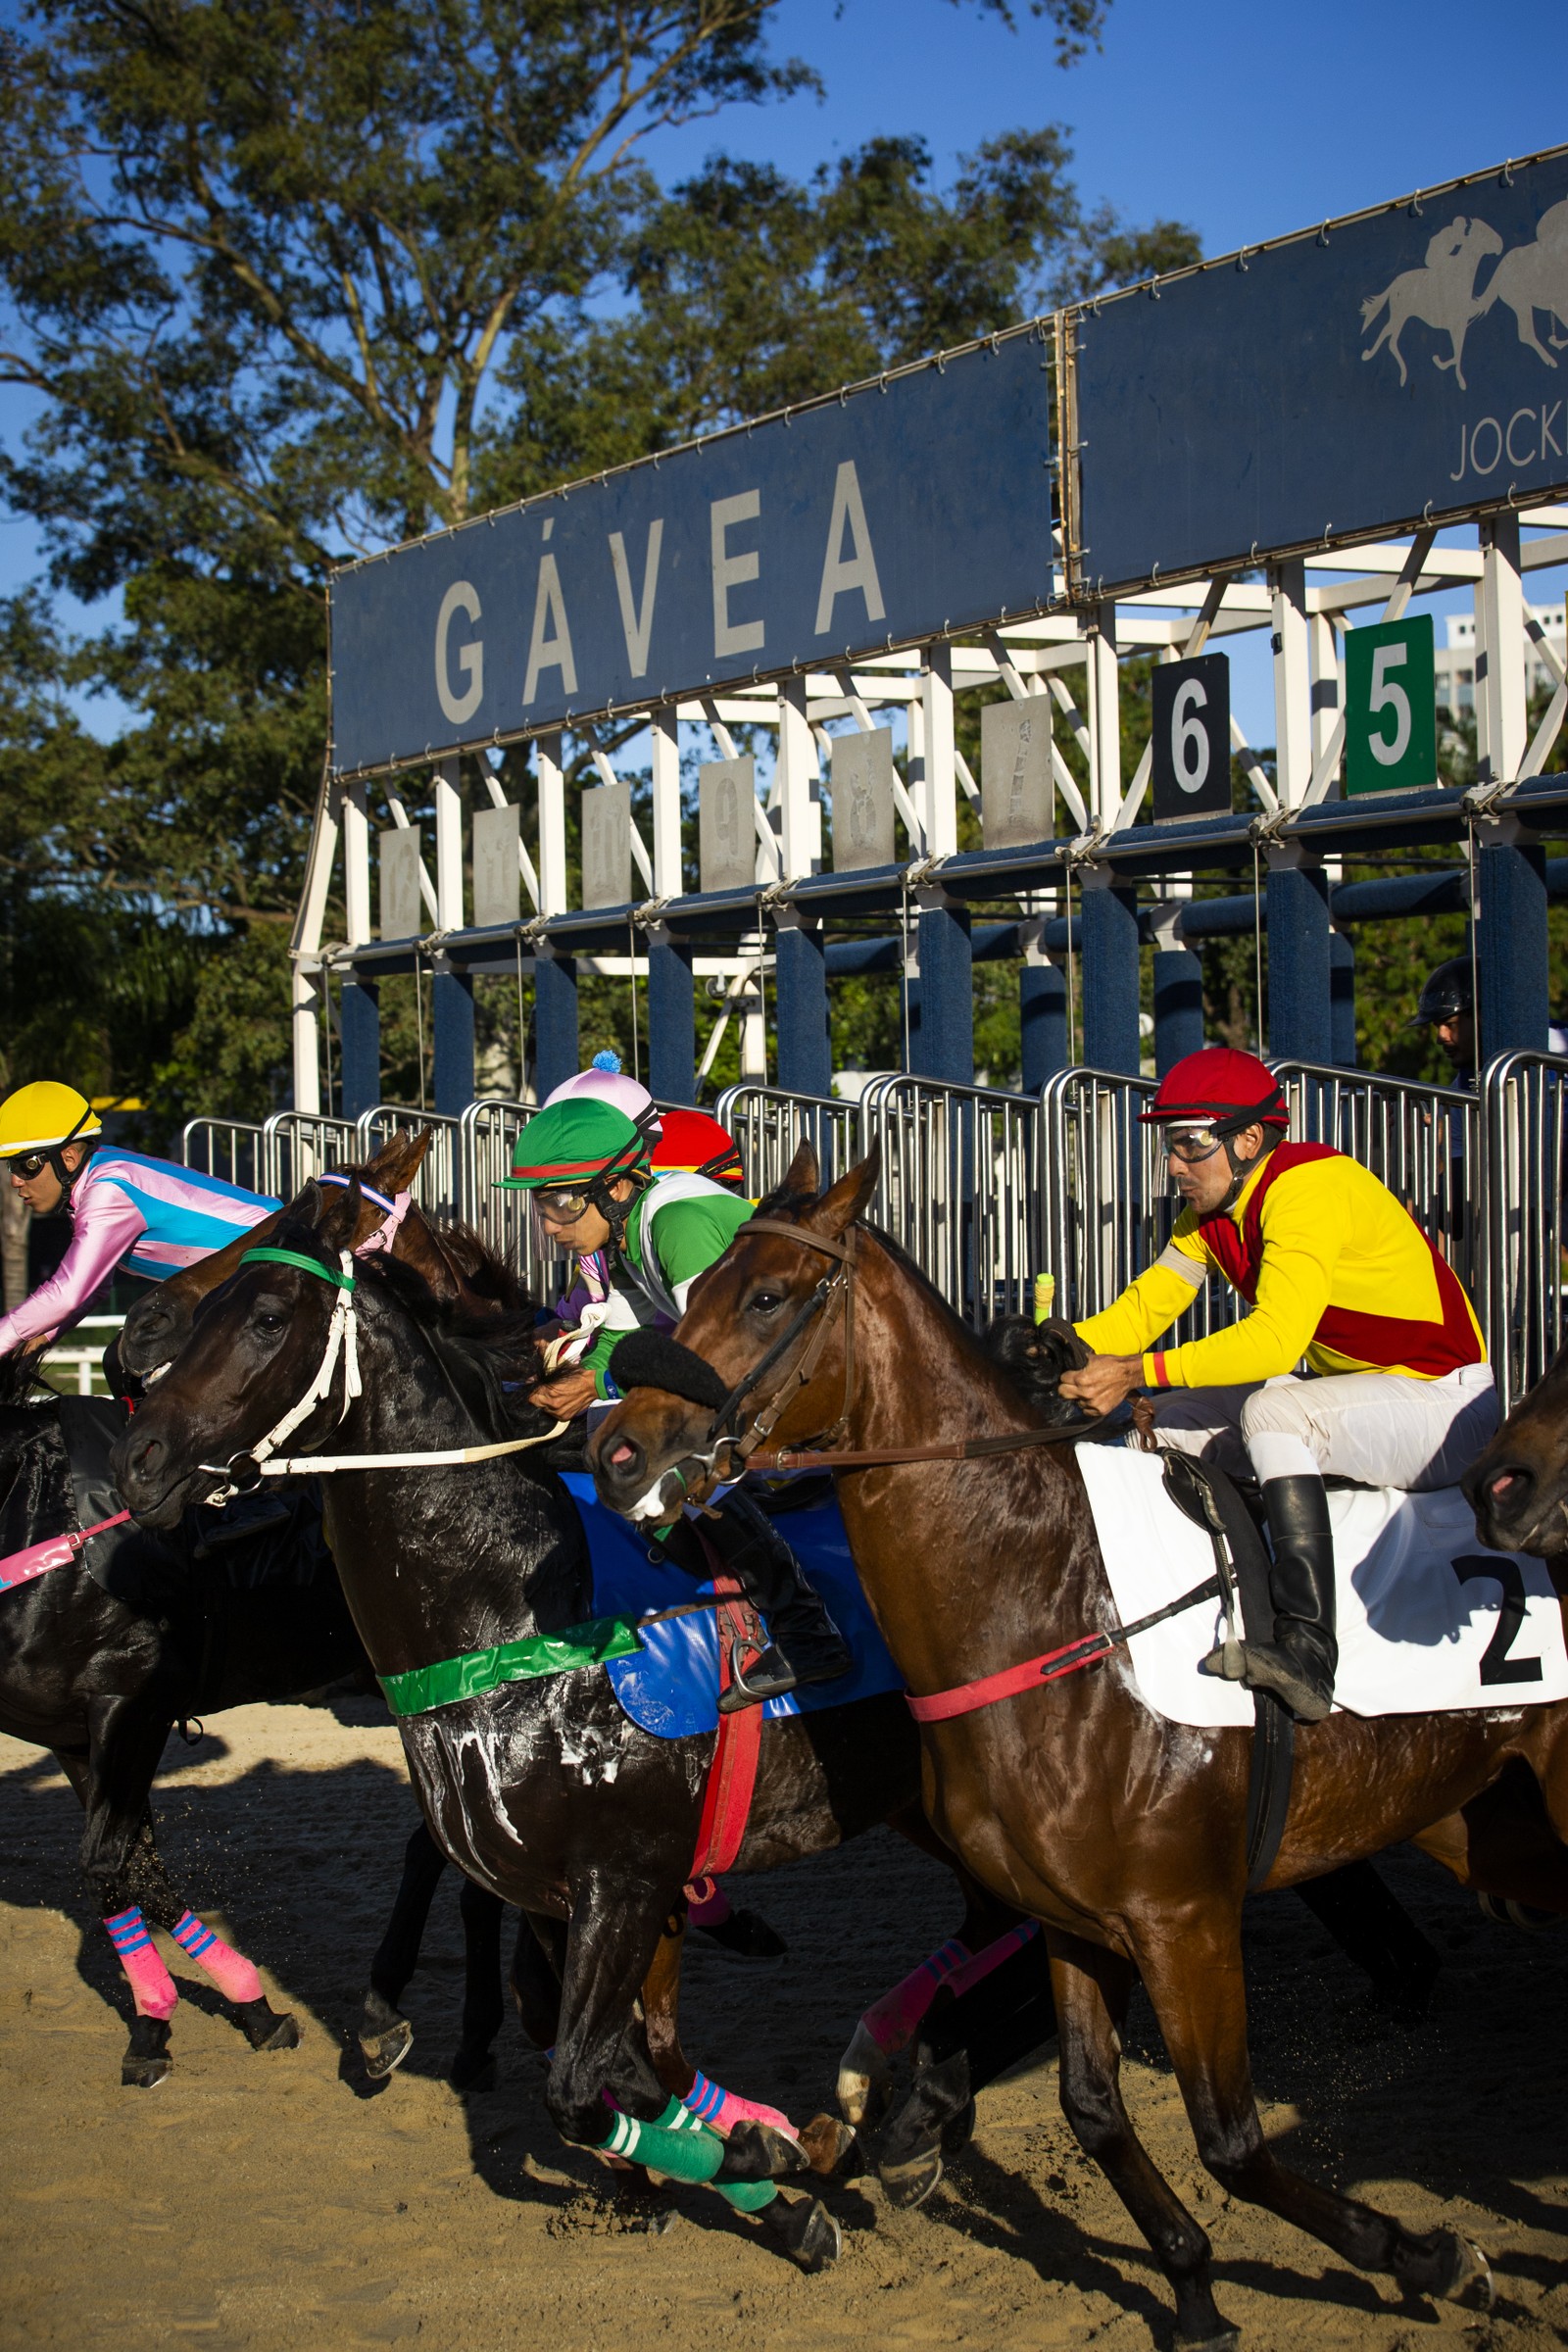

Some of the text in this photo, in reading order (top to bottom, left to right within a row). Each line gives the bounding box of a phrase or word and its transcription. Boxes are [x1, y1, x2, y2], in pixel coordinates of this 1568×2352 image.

[1450, 400, 1568, 481] JOCK
[435, 460, 886, 725] GÁVEA
[1172, 678, 1210, 794] 6
[1368, 643, 1411, 765] 5
[1450, 1555, 1543, 1687] 2
